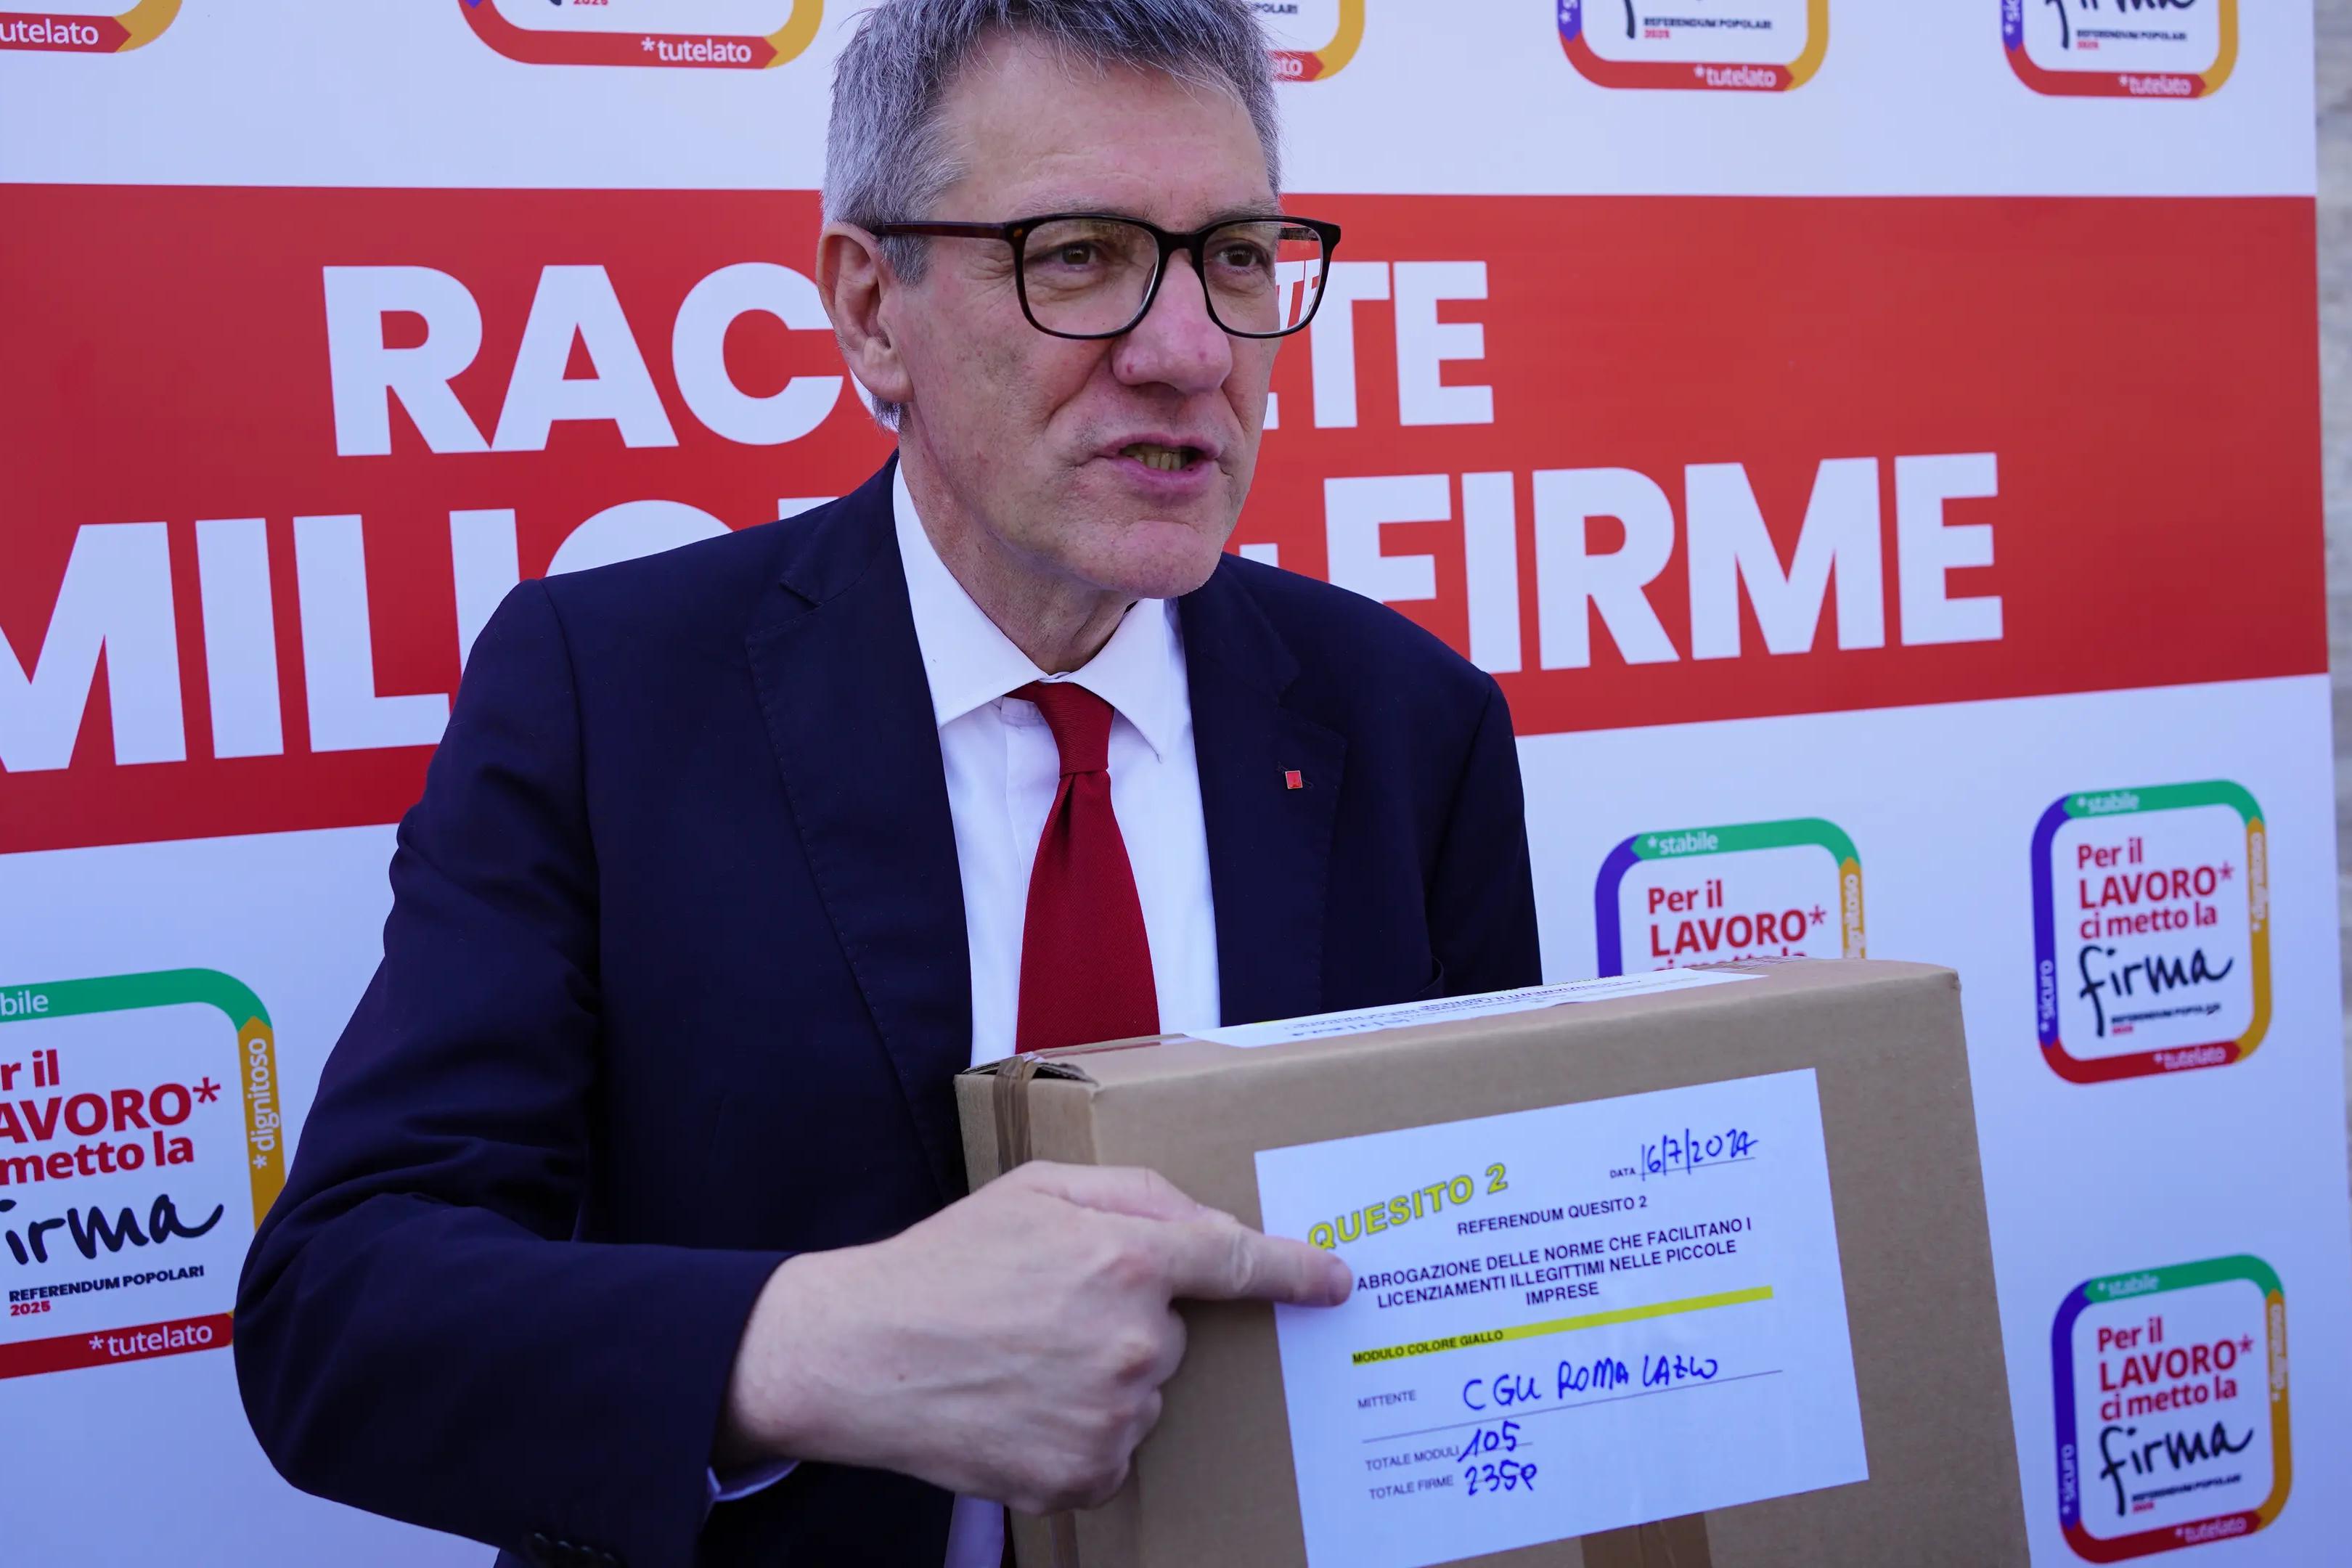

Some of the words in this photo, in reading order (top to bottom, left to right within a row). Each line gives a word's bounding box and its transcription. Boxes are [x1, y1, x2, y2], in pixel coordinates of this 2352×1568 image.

[1323, 451, 2004, 674] FIRME
[2078, 844, 2122, 870] Per
[2128, 837, 2144, 864] il
[1648, 887, 1699, 914] Per
[1706, 879, 1723, 909] il
[2081, 911, 2101, 939] ci
[2107, 907, 2189, 936] metto
[2195, 901, 2217, 927] la
[2079, 945, 2234, 1038] firma
[32, 1048, 60, 1088] il
[0, 1142, 144, 1185] metto
[153, 1130, 194, 1167] la
[1609, 1167, 1636, 1179] DATA
[1309, 1174, 1474, 1250] QUESITO
[1485, 1161, 1508, 1195] 2
[1457, 1208, 1564, 1236] REFERENDUM
[1568, 1197, 1635, 1219] QUESITO
[1638, 1195, 1648, 1209] 2
[1357, 1259, 1482, 1291] ABROGAZIONE
[1486, 1249, 1540, 1271] DELLE
[1545, 1239, 1604, 1262] NORME
[1609, 1233, 1643, 1251] CHE
[1647, 1218, 1742, 1245] FACILITANO
[1377, 1275, 1506, 1309] LICENZIAMENTI
[1510, 1260, 1605, 1287] ILLEGITTIMI
[1609, 1251, 1662, 1271] NELLE
[1667, 1239, 1737, 1263] PICCOLE
[9, 1276, 120, 1302] REFERENDUM
[123, 1265, 205, 1288] POPOLARI
[1525, 1282, 1600, 1305] IMPRESE
[1352, 1346, 1405, 1364] MODULO
[1407, 1337, 1457, 1356] COLORE
[1459, 1330, 1504, 1347] GIALLO
[2097, 1326, 2142, 1353] Per
[2148, 1315, 2163, 1344] il
[1558, 1357, 1629, 1400] ROMA
[2100, 1392, 2121, 1421] ci
[2127, 1384, 2209, 1417] metto
[2214, 1374, 2237, 1400] la
[1357, 1389, 1417, 1410] MITTENTE
[1365, 1453, 1411, 1472] TOTALE
[1413, 1445, 1460, 1463] MODULI
[1457, 1420, 1521, 1463] 105
[1369, 1480, 1416, 1500] TOTALE
[1417, 1475, 1455, 1492] FIRME
[2099, 1421, 2254, 1517] firma
